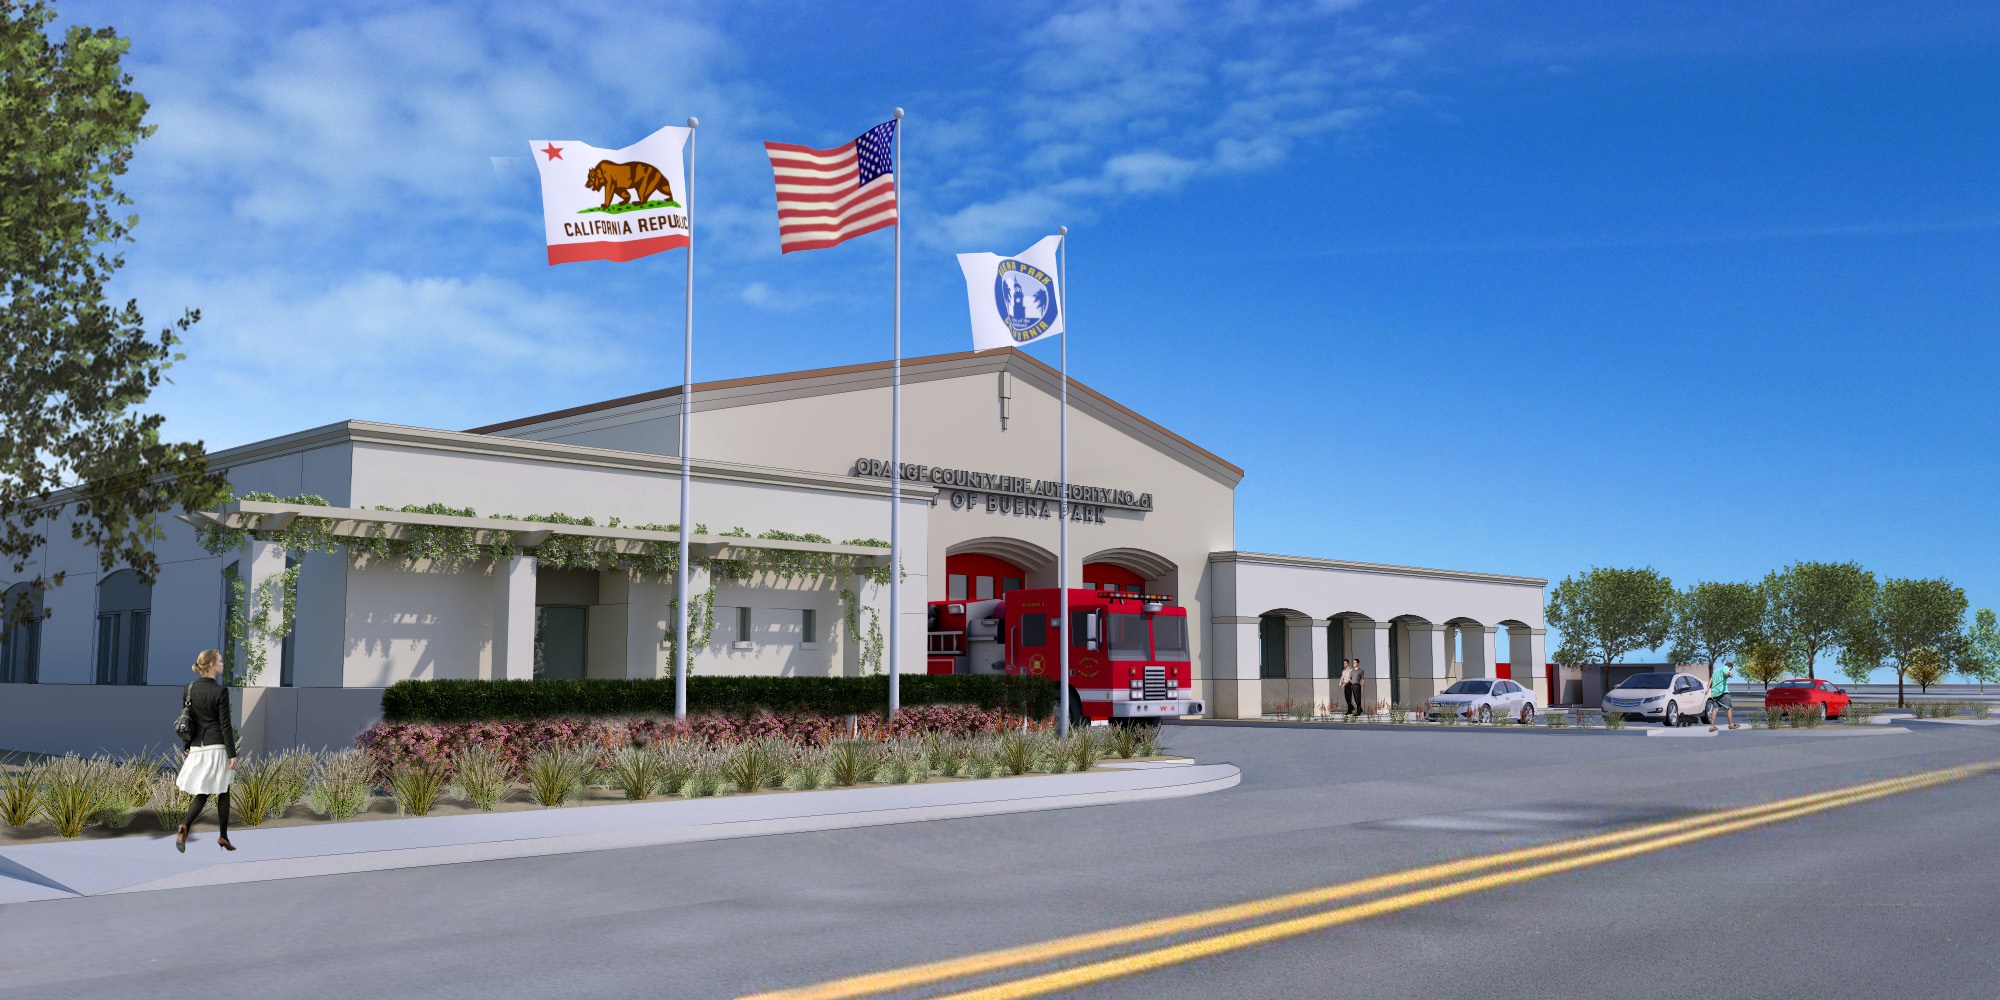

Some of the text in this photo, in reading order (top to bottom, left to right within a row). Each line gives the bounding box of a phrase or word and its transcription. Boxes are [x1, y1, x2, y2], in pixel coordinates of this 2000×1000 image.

[564, 213, 689, 237] CALIFORNIA REPUBLIC
[1020, 263, 1052, 285] PARK
[1004, 316, 1048, 341] CFORNIA
[855, 457, 1153, 508] ORANGE COUNTY FIRE AUTHORITY NO. 61
[952, 491, 978, 510] OF
[986, 494, 1051, 517] BUENA
[1059, 501, 1106, 524] PARK
